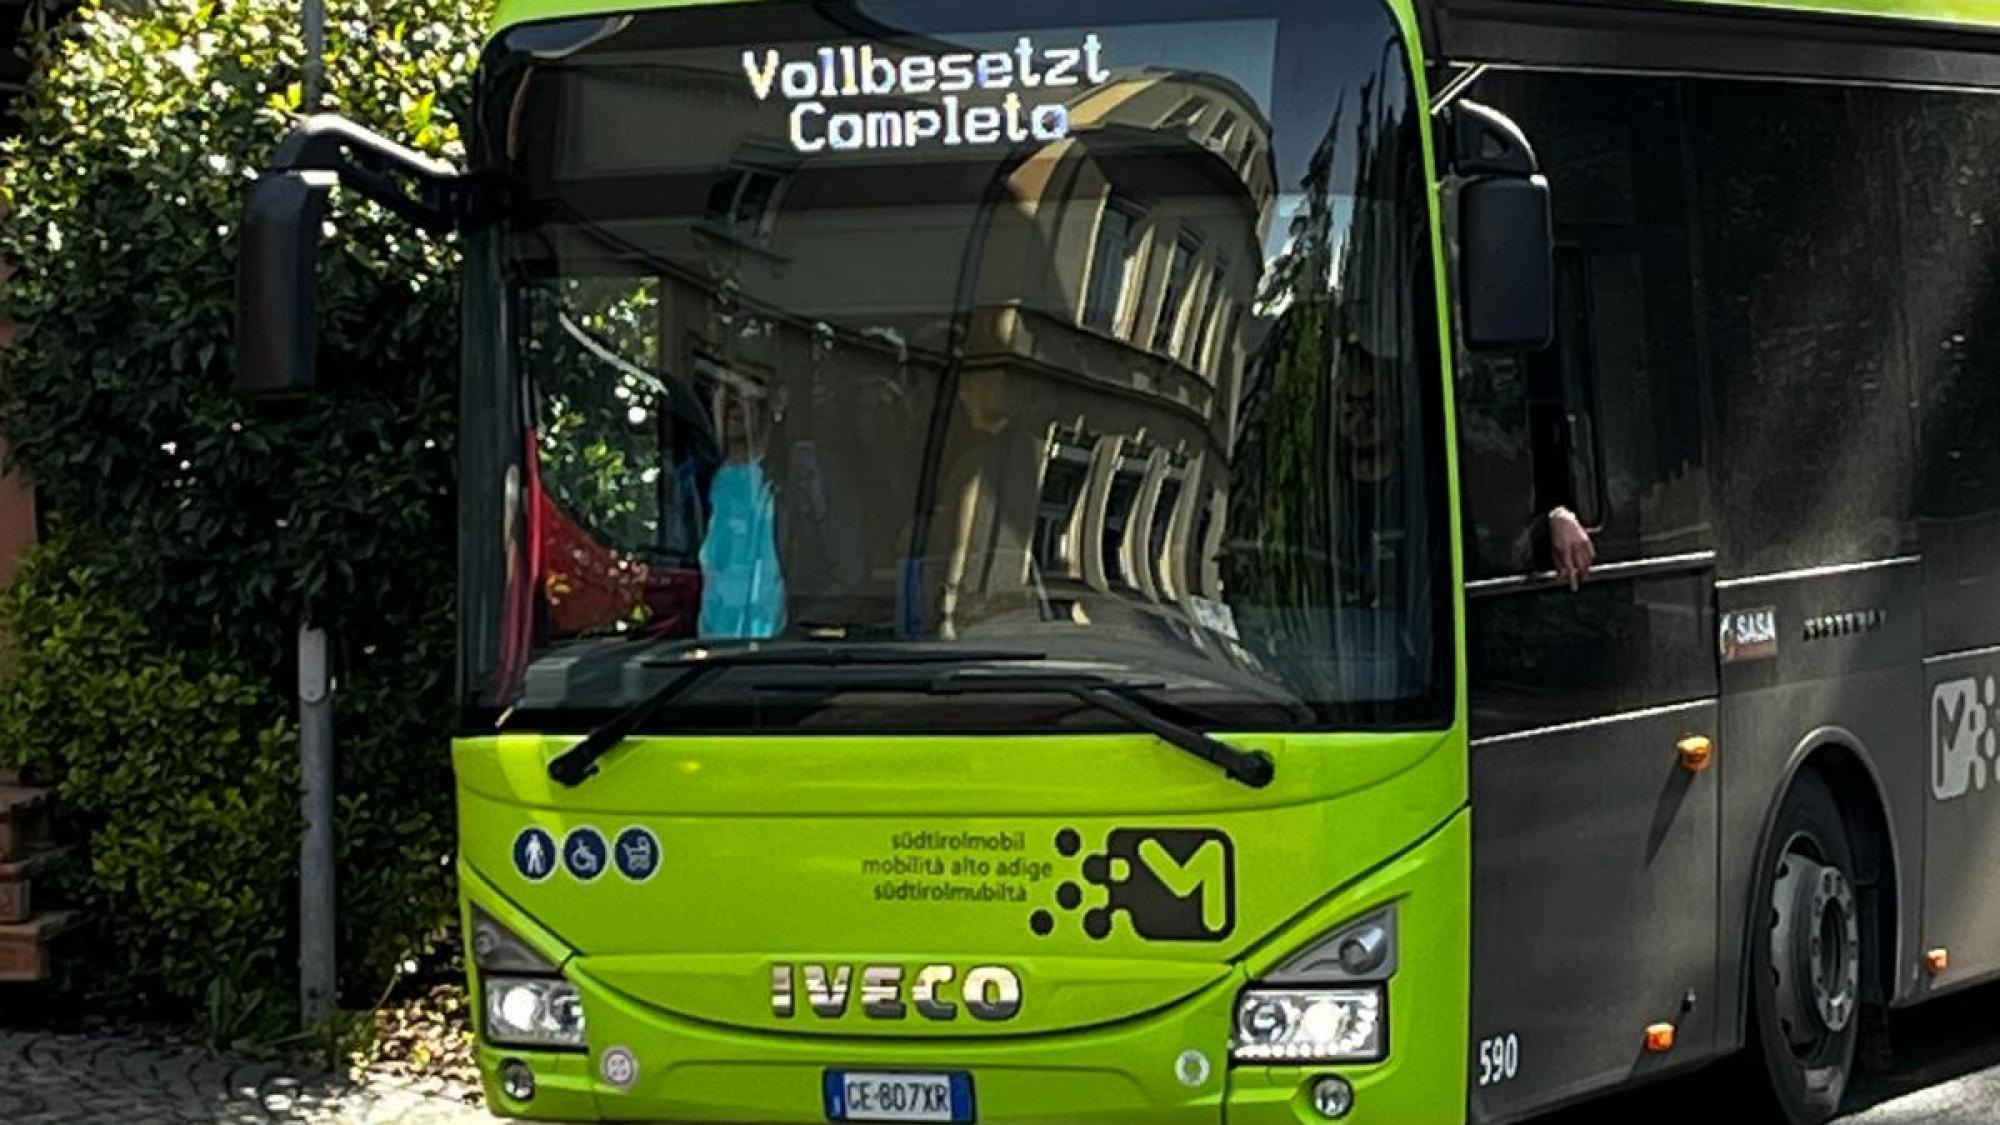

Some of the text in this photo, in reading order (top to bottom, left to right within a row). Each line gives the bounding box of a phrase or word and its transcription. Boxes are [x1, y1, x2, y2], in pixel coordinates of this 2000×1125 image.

[741, 33, 1111, 99] Vollbesetzt
[788, 93, 1070, 152] Completo
[892, 831, 1026, 851] südtirolmobil
[862, 856, 1054, 882] mobilità alto adige
[770, 963, 1022, 1021] IVECO
[1479, 1033, 1518, 1085] 590
